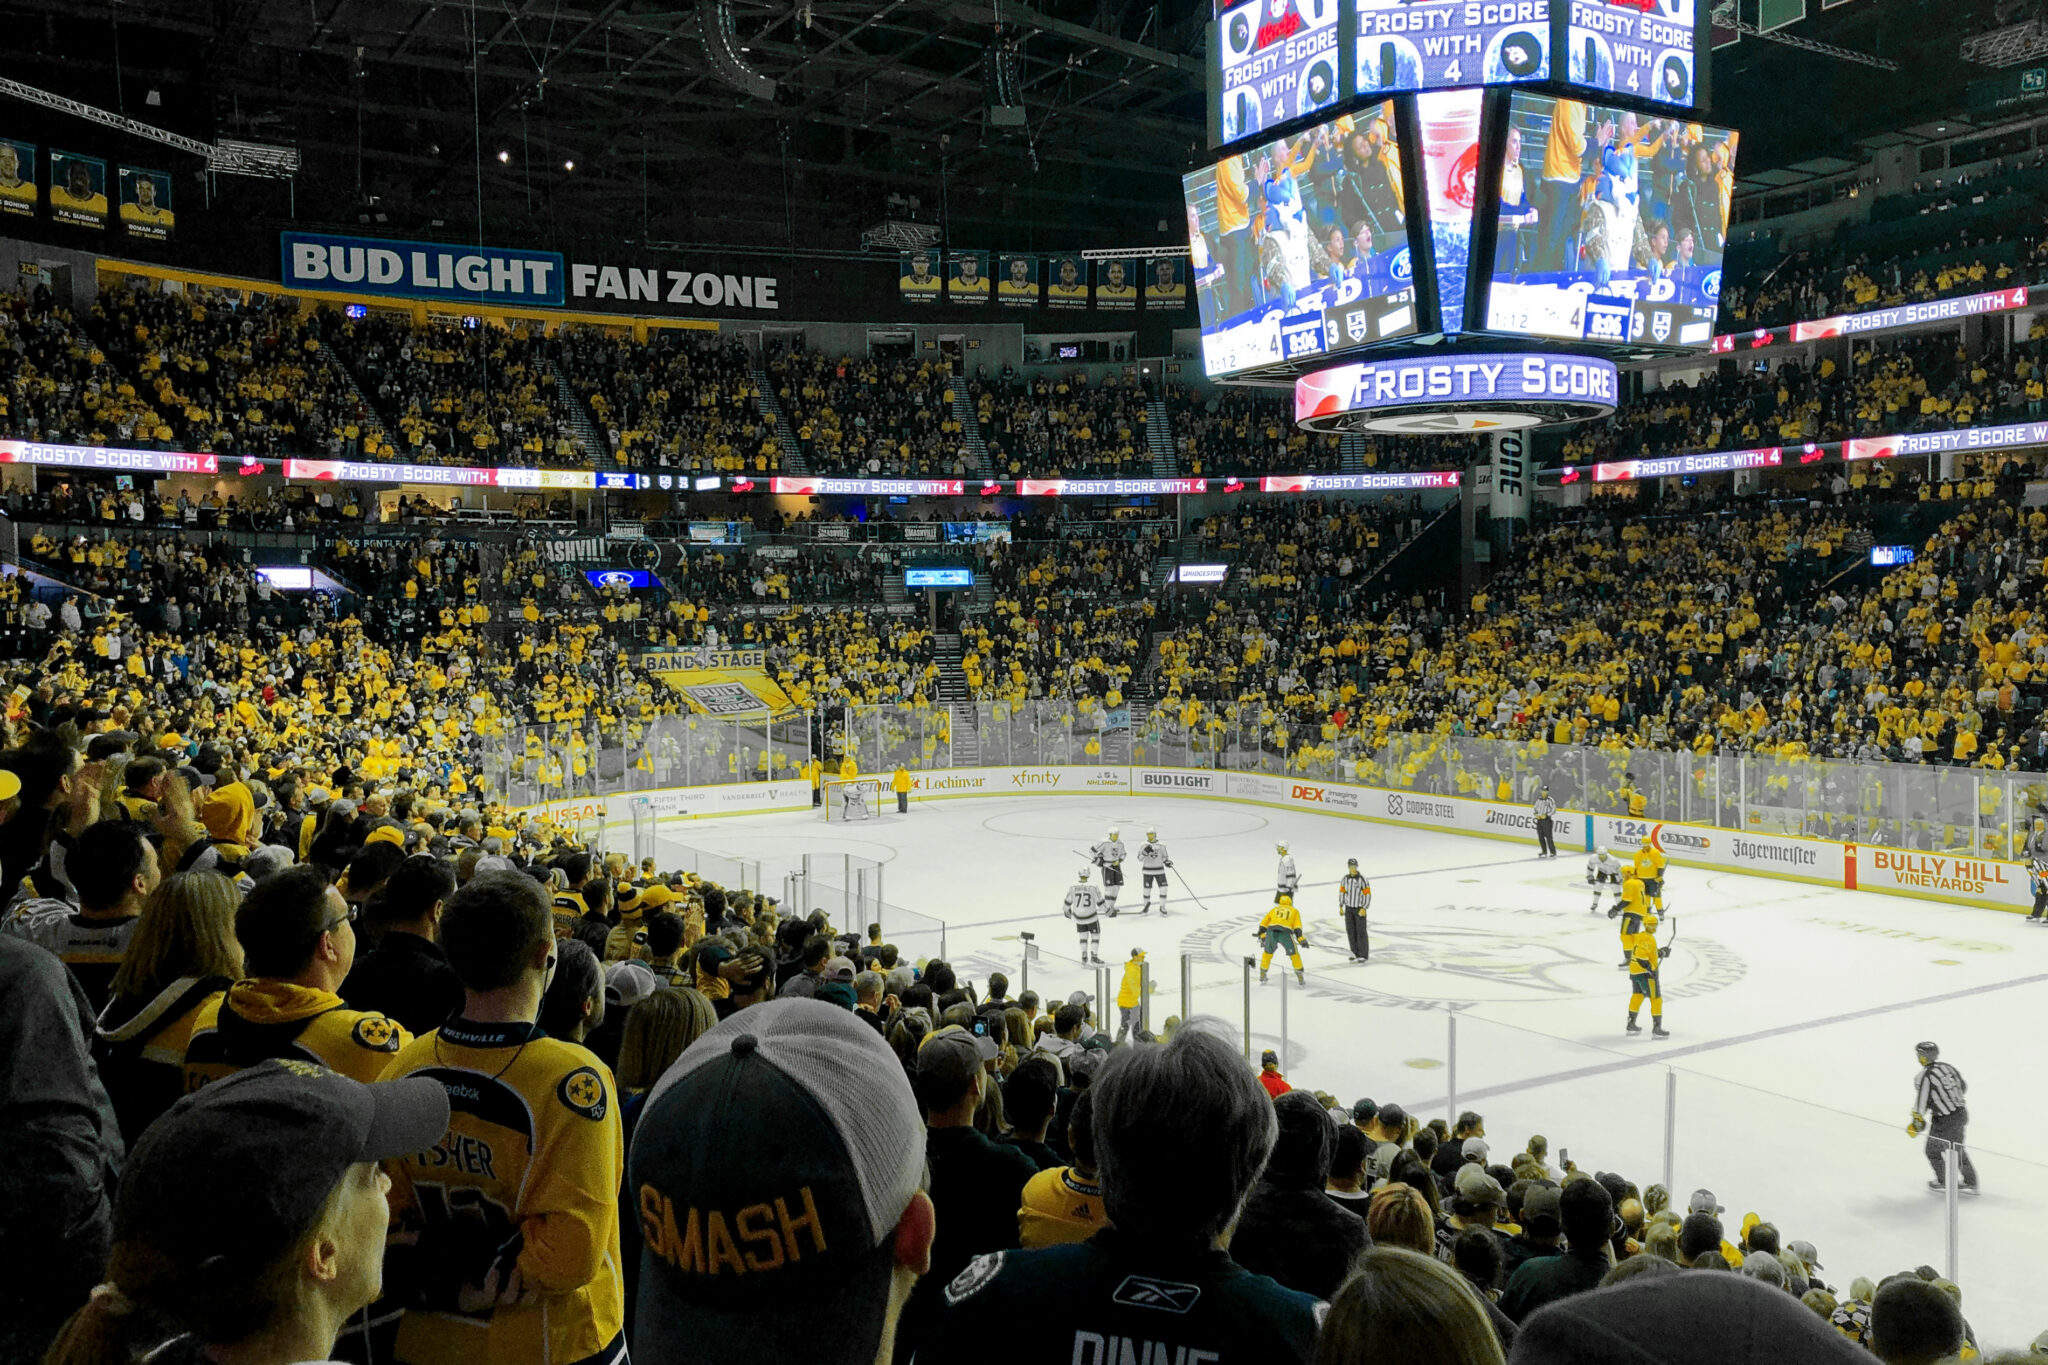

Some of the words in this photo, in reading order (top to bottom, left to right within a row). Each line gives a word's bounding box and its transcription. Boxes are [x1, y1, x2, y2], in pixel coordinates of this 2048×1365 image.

[1361, 8, 1454, 34] FROSTY
[1465, 1, 1549, 26] SCORE
[1571, 6, 1636, 37] FROSTY
[1640, 18, 1693, 50] SCORE
[1424, 34, 1482, 57] WITH
[1613, 42, 1651, 67] WITH
[1225, 52, 1279, 89] FROSTY
[1285, 28, 1338, 64] SCORE
[1444, 59, 1462, 82] 4
[1627, 69, 1639, 91] 4
[1261, 70, 1297, 100] WITH
[1274, 98, 1285, 119] 4
[293, 242, 403, 284] BUD
[412, 252, 553, 294] LIGHT
[572, 263, 658, 301] FAN
[666, 271, 779, 309] ZONE
[1570, 308, 1580, 329] 4
[1843, 311, 1900, 331] FROSTY
[1906, 301, 1960, 321] SCORE
[1966, 295, 2005, 313] WITH
[2012, 288, 2025, 305] 4
[1328, 320, 1339, 344] 3
[1592, 314, 1622, 335] 8:06
[1632, 313, 1644, 337] 3
[1270, 335, 1279, 355] 4
[1289, 332, 1318, 353] 8:06
[1723, 337, 1733, 349] 4
[1210, 355, 1236, 371] 1:12
[1354, 363, 1502, 402] FROSTY
[1522, 356, 1611, 399] SCORE
[1900, 433, 1960, 453] FROSTY
[1968, 428, 2022, 446] SCORE
[21, 444, 87, 464] FROSTY
[95, 450, 153, 468] SCORE
[160, 455, 198, 470] WITH
[204, 457, 216, 471] 4
[1636, 458, 1682, 477] FROSTY
[1685, 455, 1729, 473] SCORE
[1733, 453, 1765, 469] WITH
[1769, 450, 1780, 464] 4
[340, 464, 398, 480] FROSTY
[403, 466, 451, 482] SCORE
[456, 470, 490, 483] WITH
[506, 477, 532, 486] 1:12
[607, 478, 625, 487] 8:06
[641, 475, 650, 488] 3
[1308, 477, 1357, 489] FROSTY
[1362, 474, 1407, 487] SCORE
[1412, 474, 1442, 486] WITH
[1447, 473, 1457, 485] 4
[818, 481, 867, 492] FROSTY
[871, 481, 913, 493] SCORE
[918, 483, 948, 493] WITH
[952, 481, 963, 493] 4
[1062, 481, 1109, 493] FROSTY
[1114, 481, 1157, 493] SCORE
[1161, 481, 1191, 492] WITH
[1195, 480, 1205, 491] 4
[646, 656, 694, 671] BAND
[709, 652, 763, 668] STAGE
[693, 685, 741, 698] BUILT
[710, 702, 760, 712] TOUGH
[925, 775, 986, 790] Lochinvar
[1012, 769, 1061, 787] xfinity
[1144, 774, 1171, 786] BUD
[1174, 776, 1211, 788] LIGHT
[654, 796, 677, 804] FIFTH
[680, 793, 705, 801] THIRD
[722, 793, 766, 801] VANDERBILT
[1291, 785, 1325, 802] DEX
[1328, 790, 1358, 799] imaging
[1331, 799, 1358, 808] mailing
[1405, 800, 1434, 816] COOPER
[1434, 803, 1455, 819] STEEL
[1485, 809, 1572, 835] BRIDGESNE
[1874, 851, 1947, 876] BULLY
[1954, 860, 2009, 884] HILL
[1895, 870, 1986, 895] VINEYARDS
[1074, 892, 1092, 908] 73
[443, 1027, 505, 1043] NASHVILLE
[640, 1184, 827, 1277] SMASH
